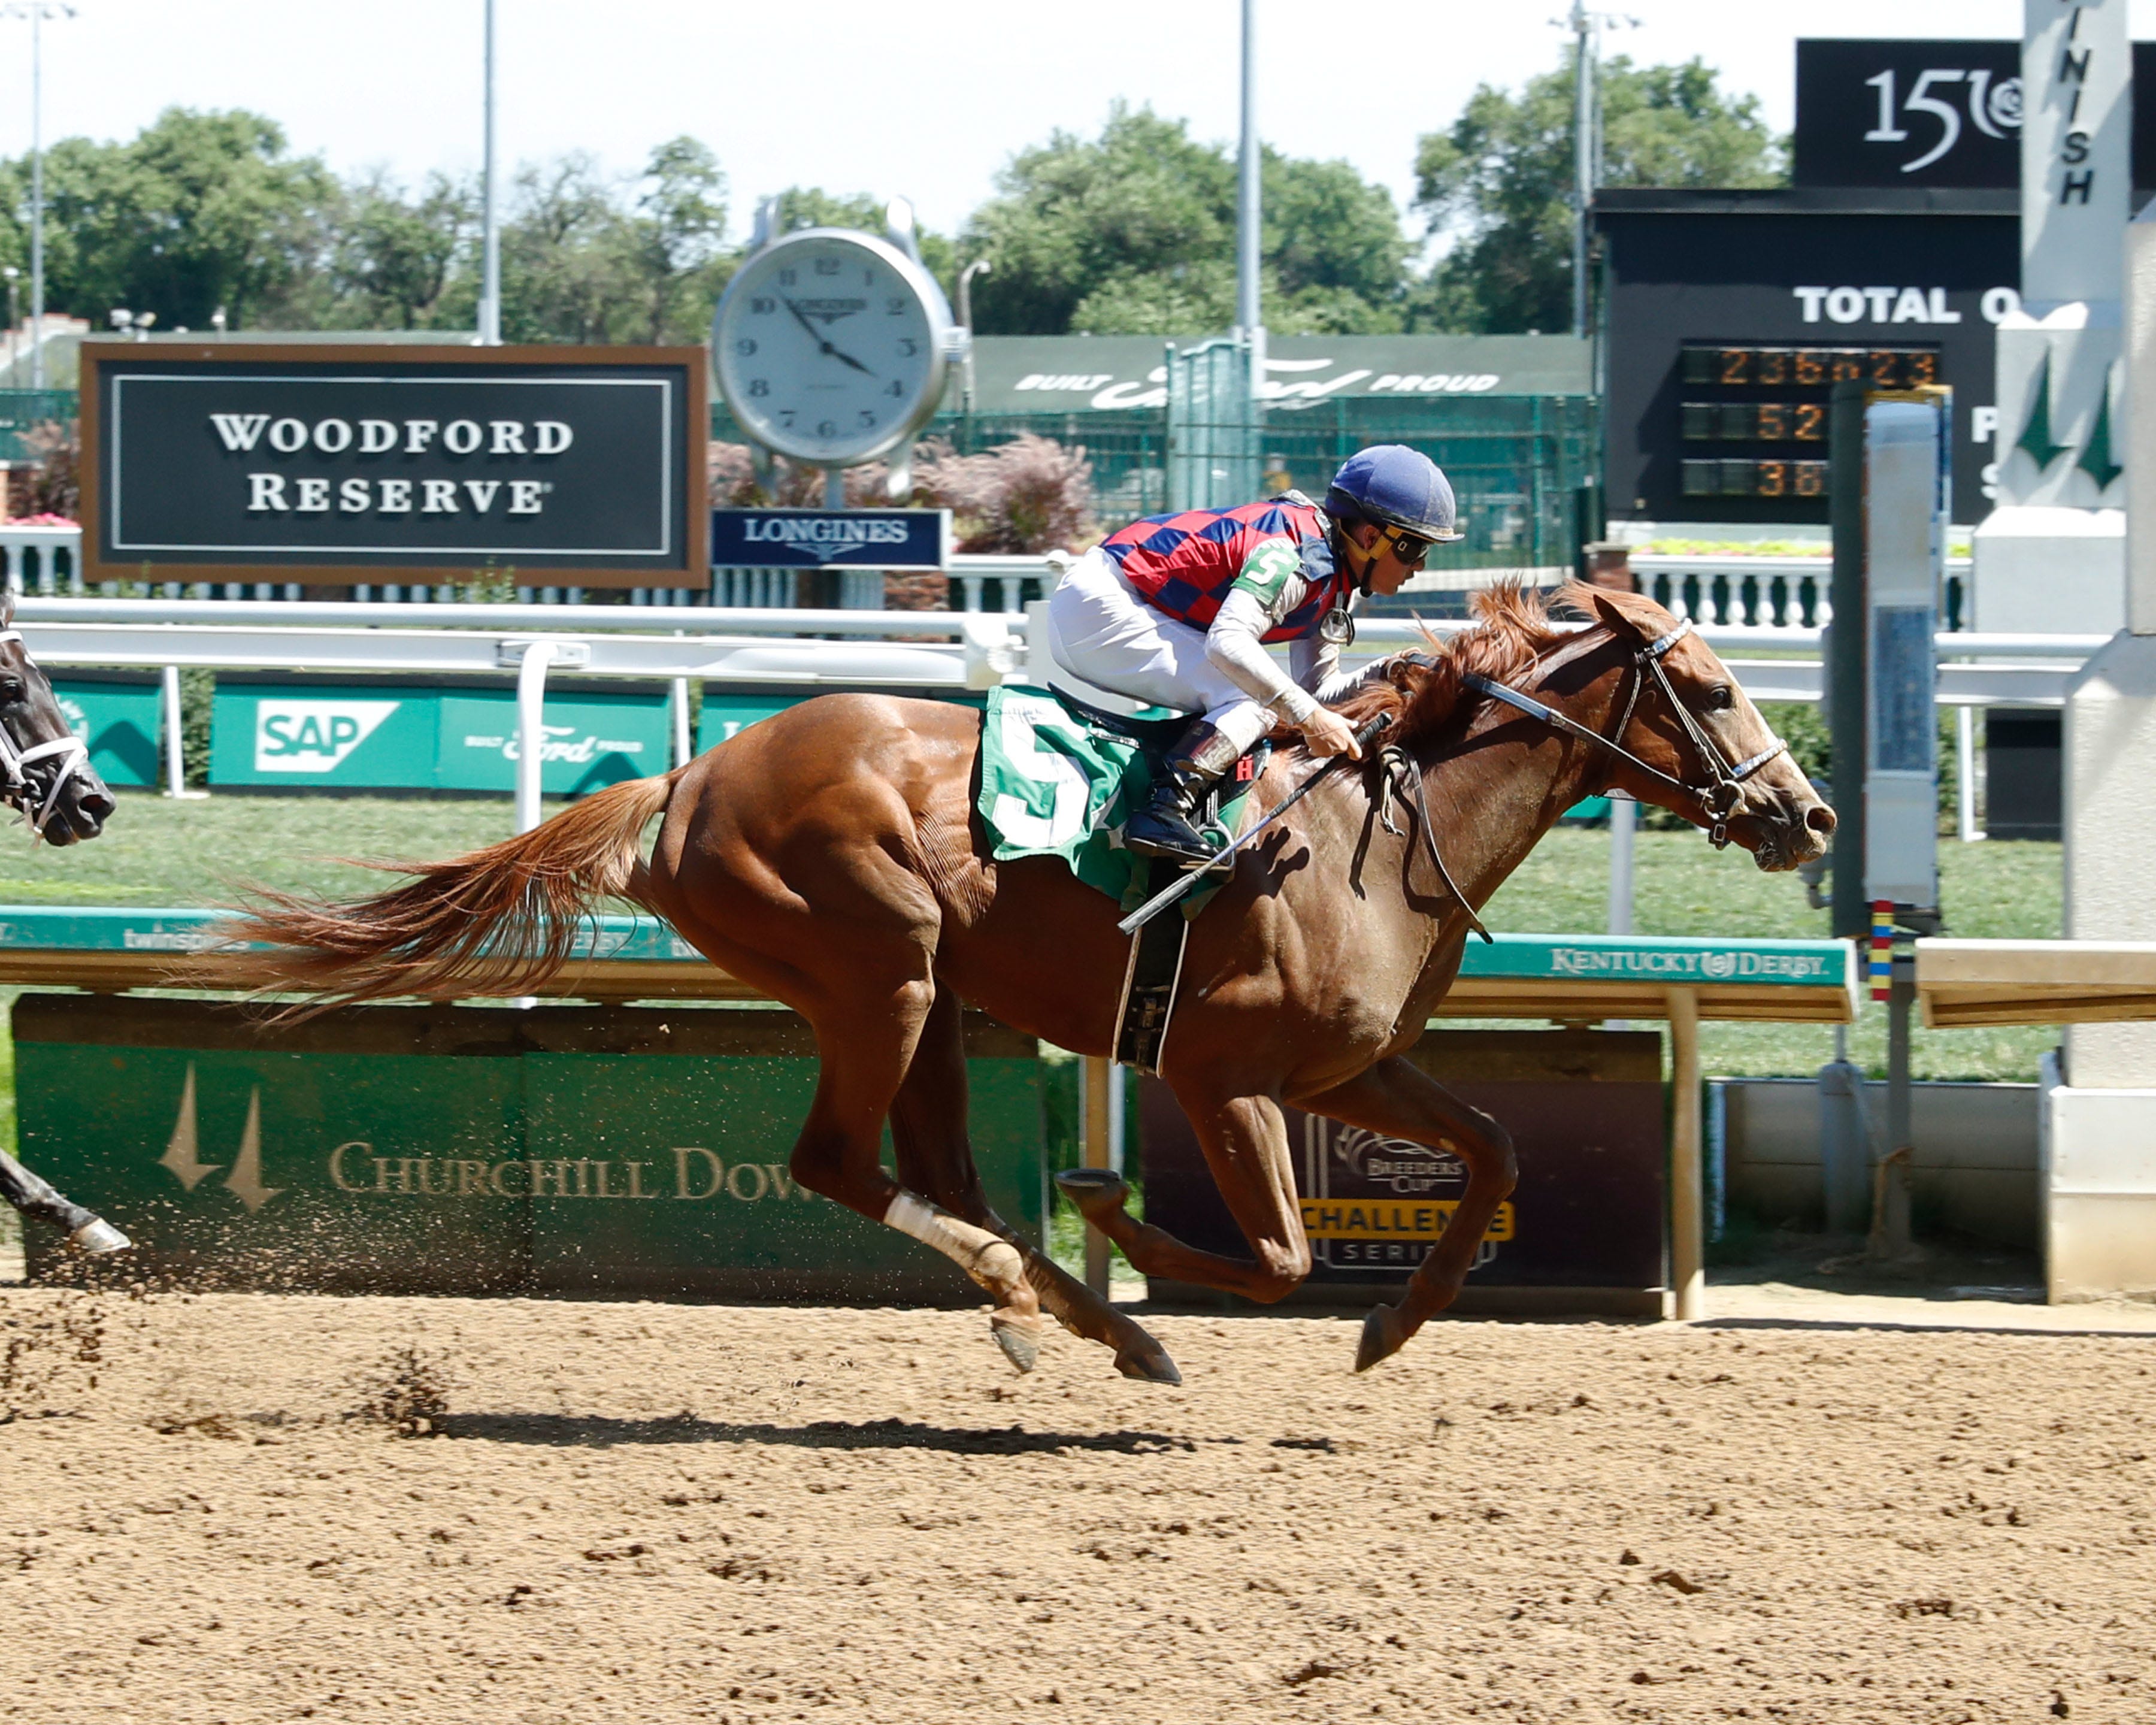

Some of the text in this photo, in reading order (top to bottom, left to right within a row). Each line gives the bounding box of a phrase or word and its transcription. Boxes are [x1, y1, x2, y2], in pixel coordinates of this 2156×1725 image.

[2058, 0, 2093, 205] INISH
[1793, 286, 1961, 324] TOTAL
[1015, 374, 1113, 391] BUILT
[1368, 374, 1500, 392] PROUD
[210, 414, 573, 453] WOODFORD
[247, 473, 543, 513] RESERVE
[744, 519, 907, 543] LONGINES
[1245, 550, 1294, 585] 5
[264, 715, 359, 756] SAP
[992, 697, 1090, 848] 5
[1551, 948, 1827, 978] KENTUCKY DERBY
[328, 1142, 834, 1200] CHURCHILL DOW
[1391, 1175, 1436, 1193] CUP
[1302, 1206, 1506, 1233] CHALLENE
[1343, 1244, 1435, 1260] SERI
